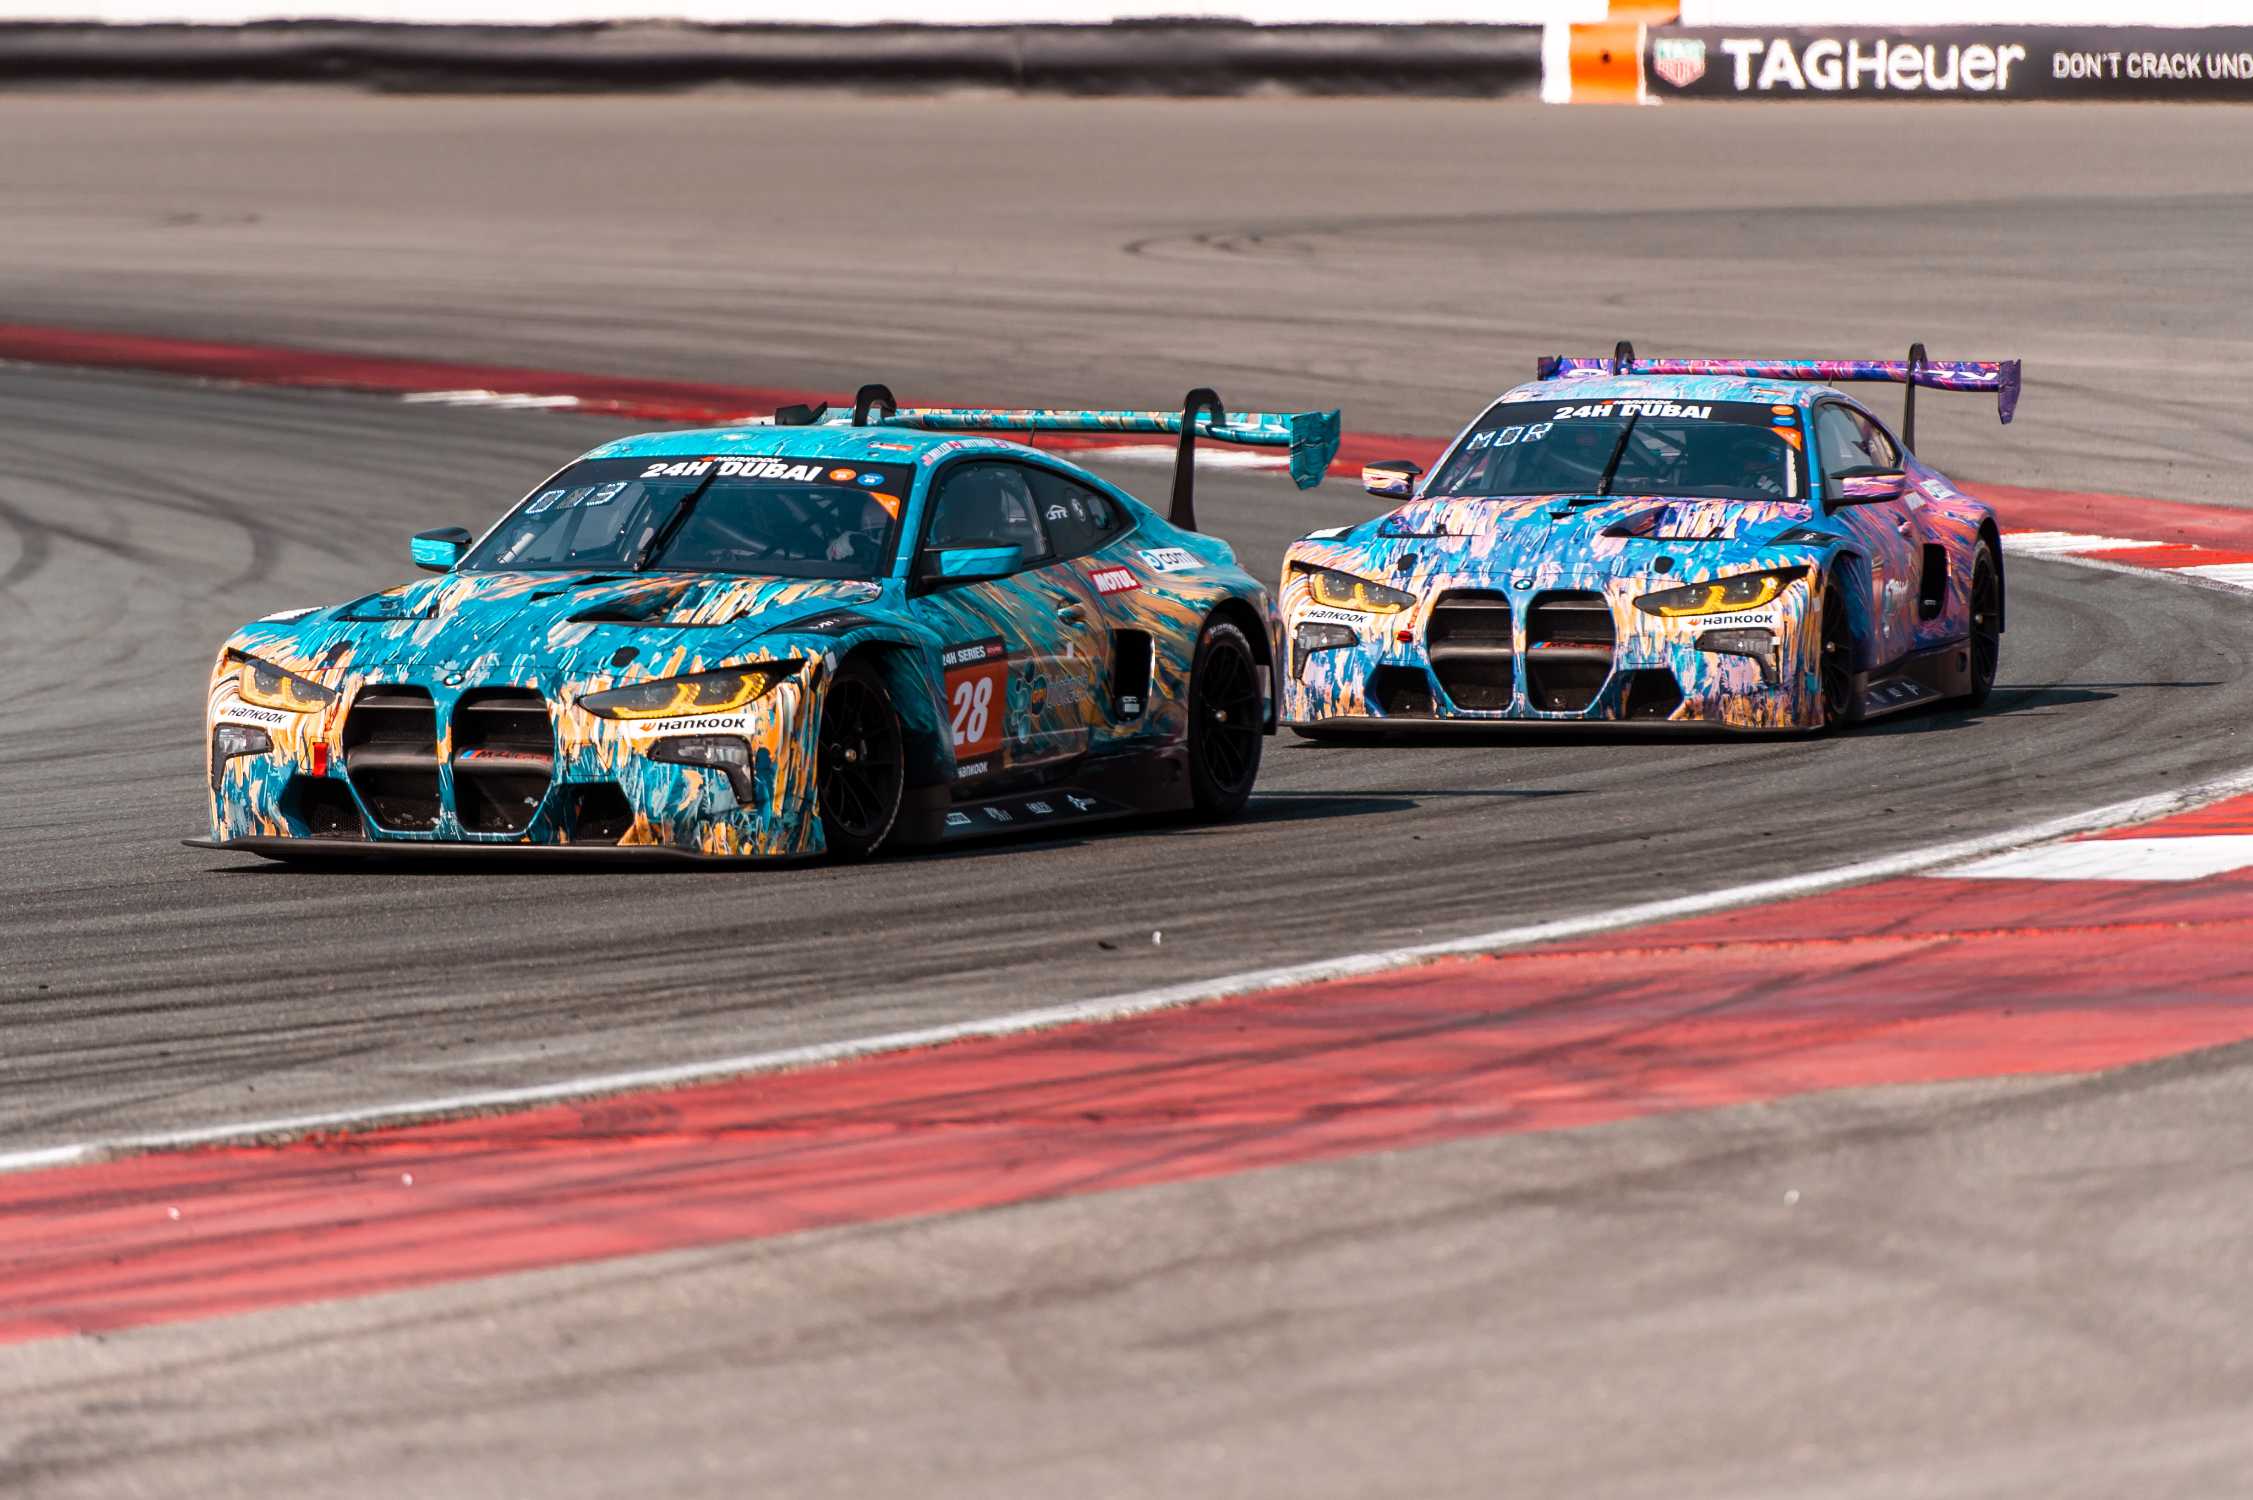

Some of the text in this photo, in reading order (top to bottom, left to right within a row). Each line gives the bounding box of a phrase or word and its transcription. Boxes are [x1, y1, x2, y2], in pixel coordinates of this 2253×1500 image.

[2052, 52, 2122, 79] DON'T
[2126, 52, 2202, 79] CRACK
[1552, 404, 1713, 420] 24H DUBAI
[639, 461, 823, 482] 24H DUBAI
[1092, 570, 1137, 593] MOTUL
[957, 645, 986, 663] SERIES
[952, 676, 993, 746] 28
